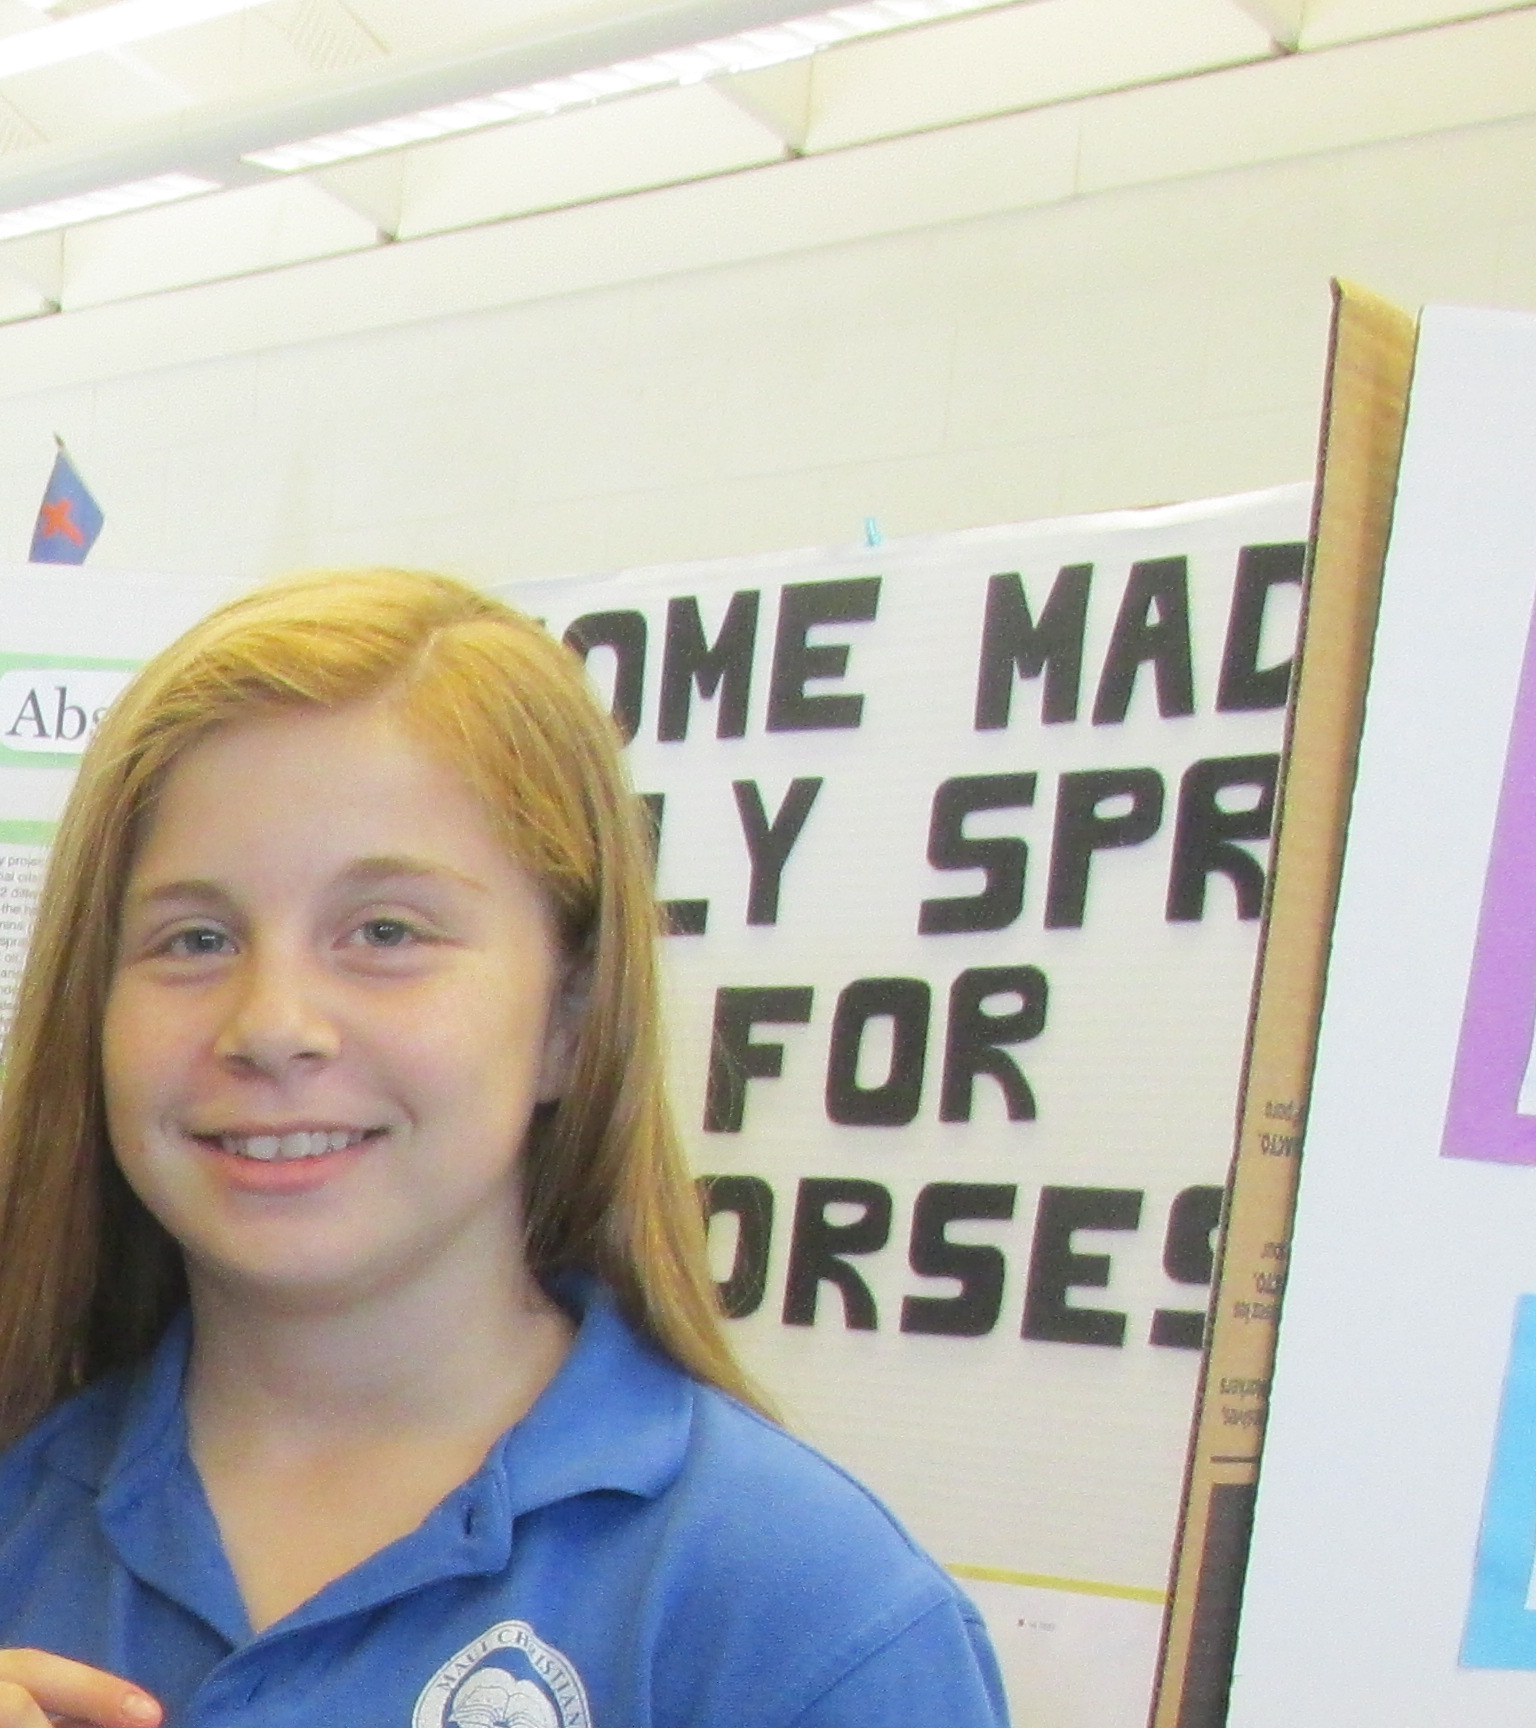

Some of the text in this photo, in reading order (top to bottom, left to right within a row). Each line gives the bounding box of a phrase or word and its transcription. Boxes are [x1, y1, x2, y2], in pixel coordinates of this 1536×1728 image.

[542, 542, 1308, 747] OME MAD
[0, 886, 7, 898] 2
[1, 904, 21, 914] the
[917, 753, 1284, 936] SPR
[703, 964, 1048, 1133] FOR
